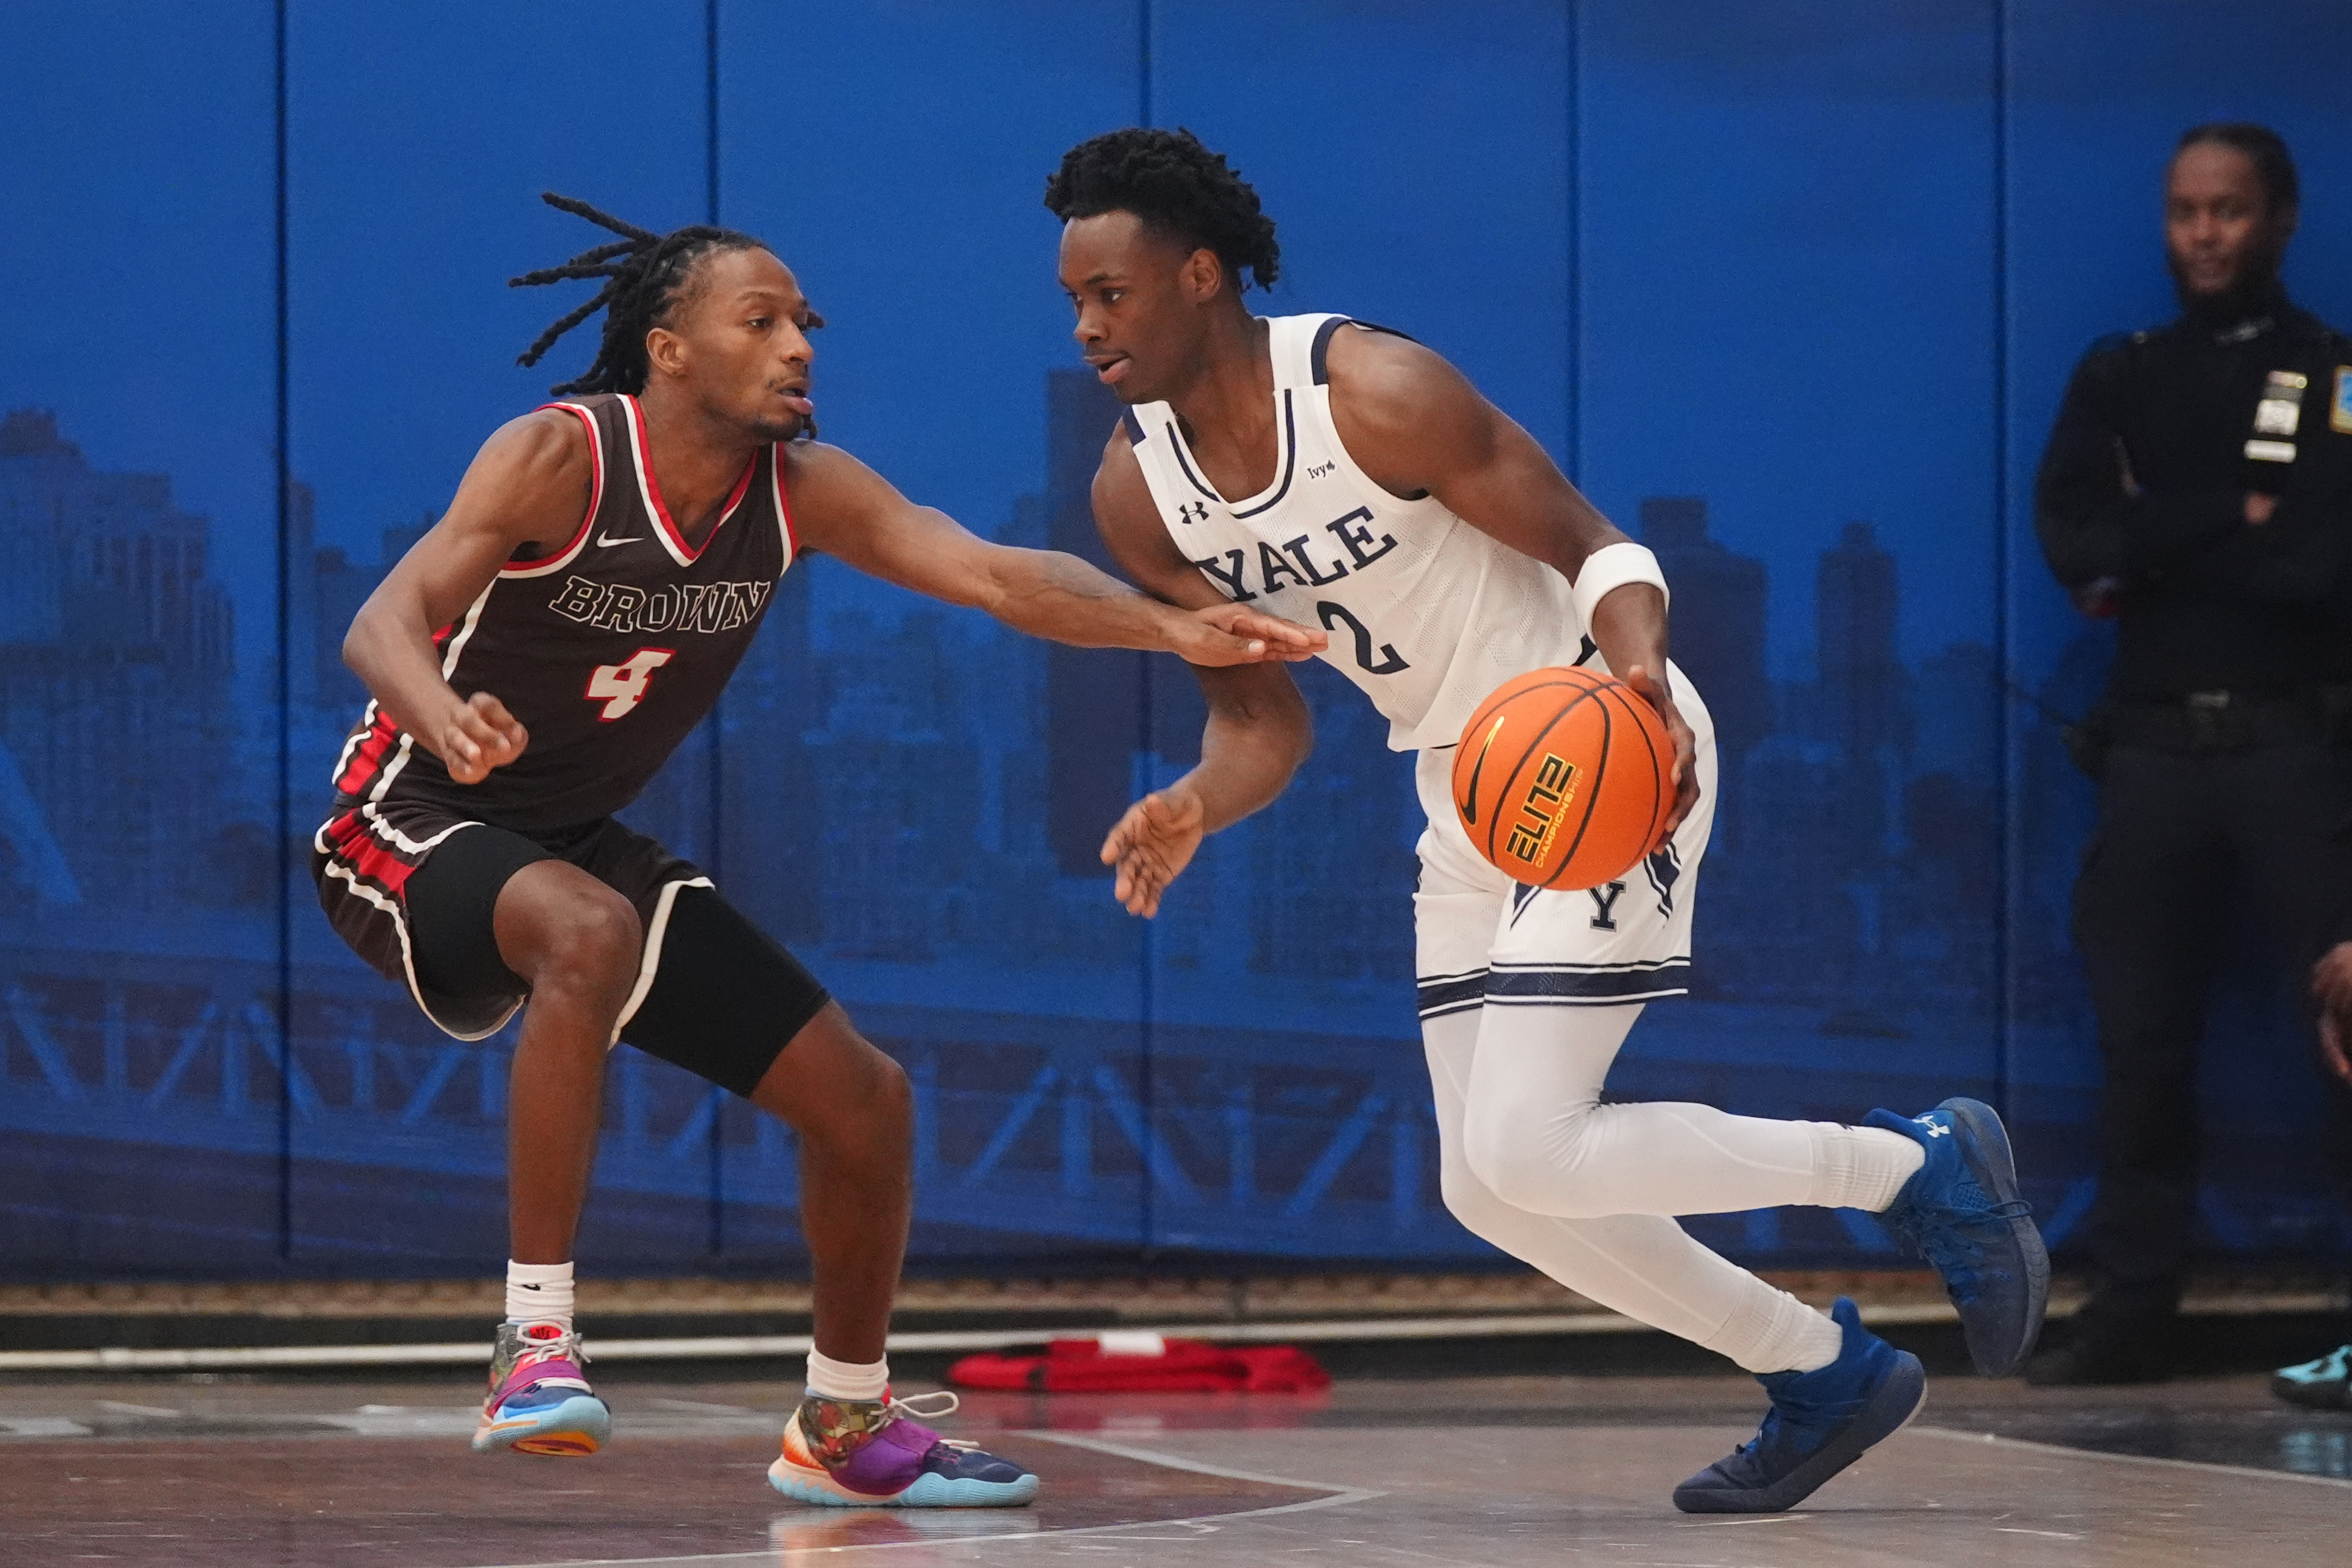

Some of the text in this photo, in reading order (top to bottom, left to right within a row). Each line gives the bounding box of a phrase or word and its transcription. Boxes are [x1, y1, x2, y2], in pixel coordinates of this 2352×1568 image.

[1307, 464, 1326, 480] Ivy
[1194, 505, 1399, 603] YALE
[548, 574, 771, 634] BROWN
[1317, 600, 1411, 675] 2
[583, 646, 677, 722] 4
[1505, 752, 1577, 865] ELITE
[1536, 768, 1584, 869] CHAMPIONSHIP
[1586, 880, 1627, 933] Y
